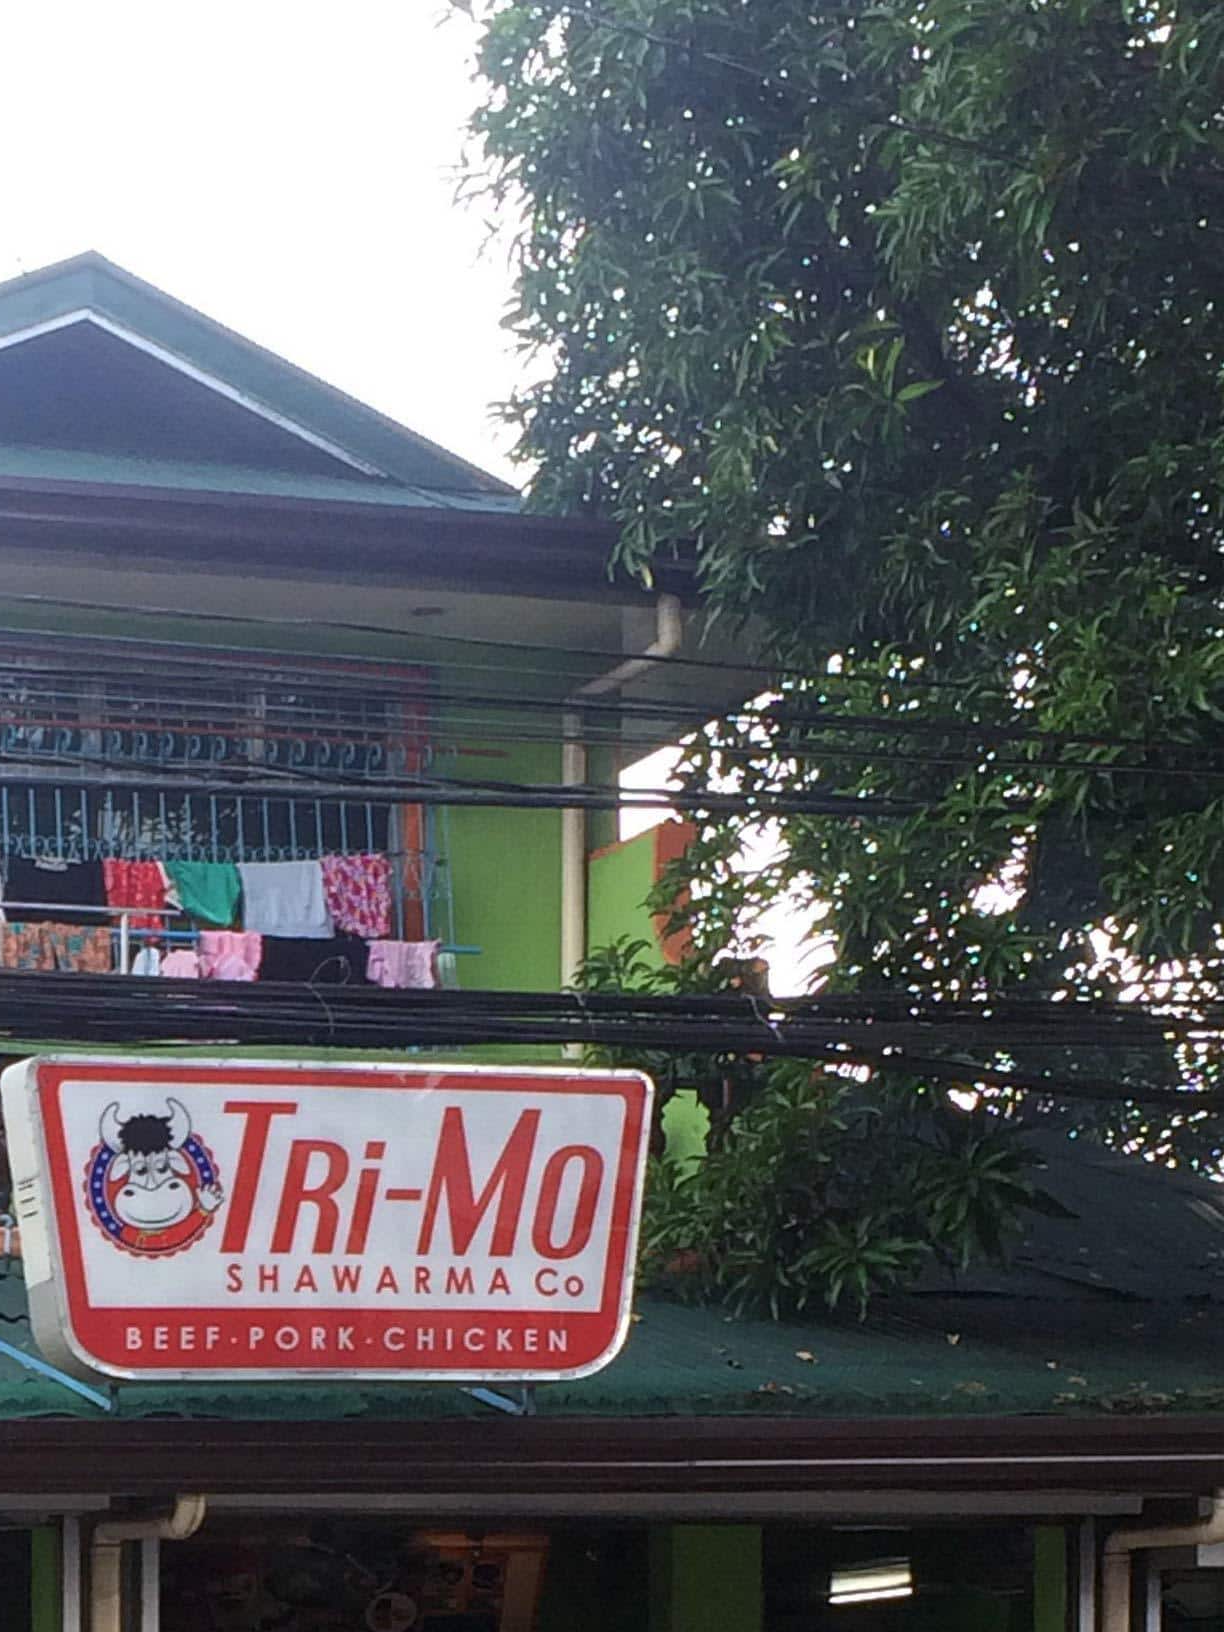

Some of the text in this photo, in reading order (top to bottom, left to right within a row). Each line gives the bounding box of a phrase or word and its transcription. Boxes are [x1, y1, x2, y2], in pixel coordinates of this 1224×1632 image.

[225, 1263, 512, 1296] SHAWARMA
[125, 1326, 569, 1354] BEEF PORK CHICKEN
